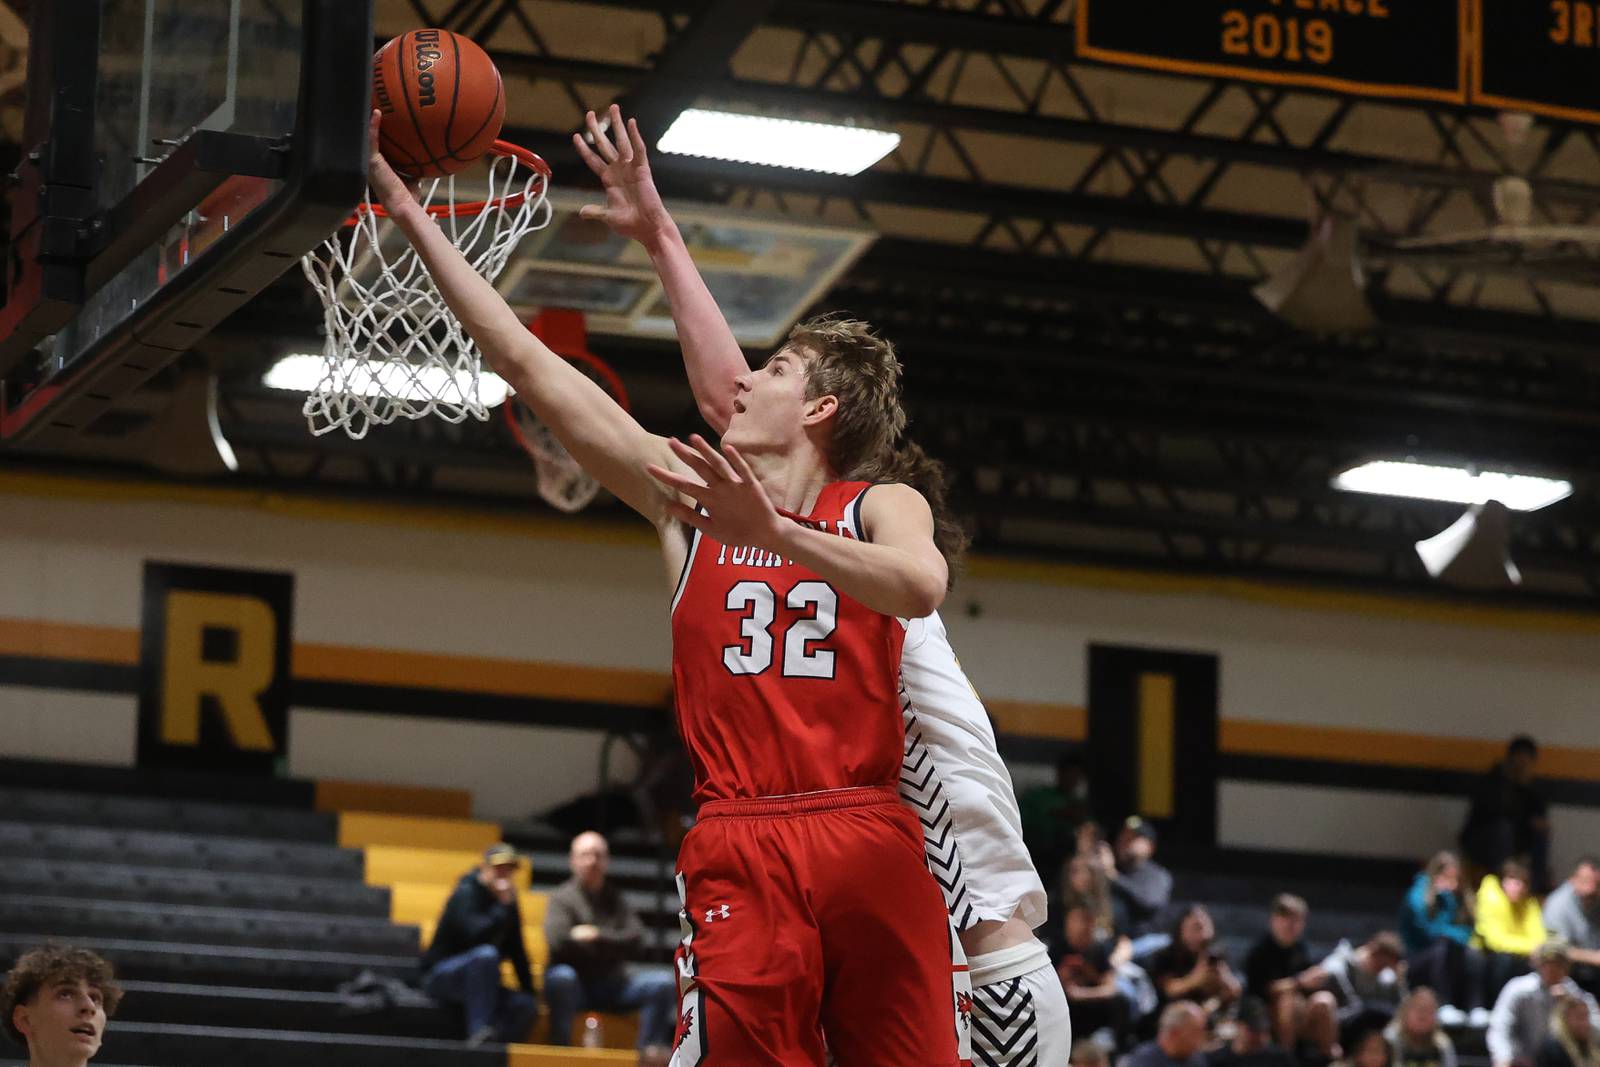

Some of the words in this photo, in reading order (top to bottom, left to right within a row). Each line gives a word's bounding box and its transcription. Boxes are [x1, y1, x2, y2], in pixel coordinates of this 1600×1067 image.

[1221, 9, 1333, 64] 2019
[1551, 0, 1600, 47] 3R
[414, 30, 442, 108] Wilson
[722, 580, 839, 680] 32
[161, 588, 277, 751] R
